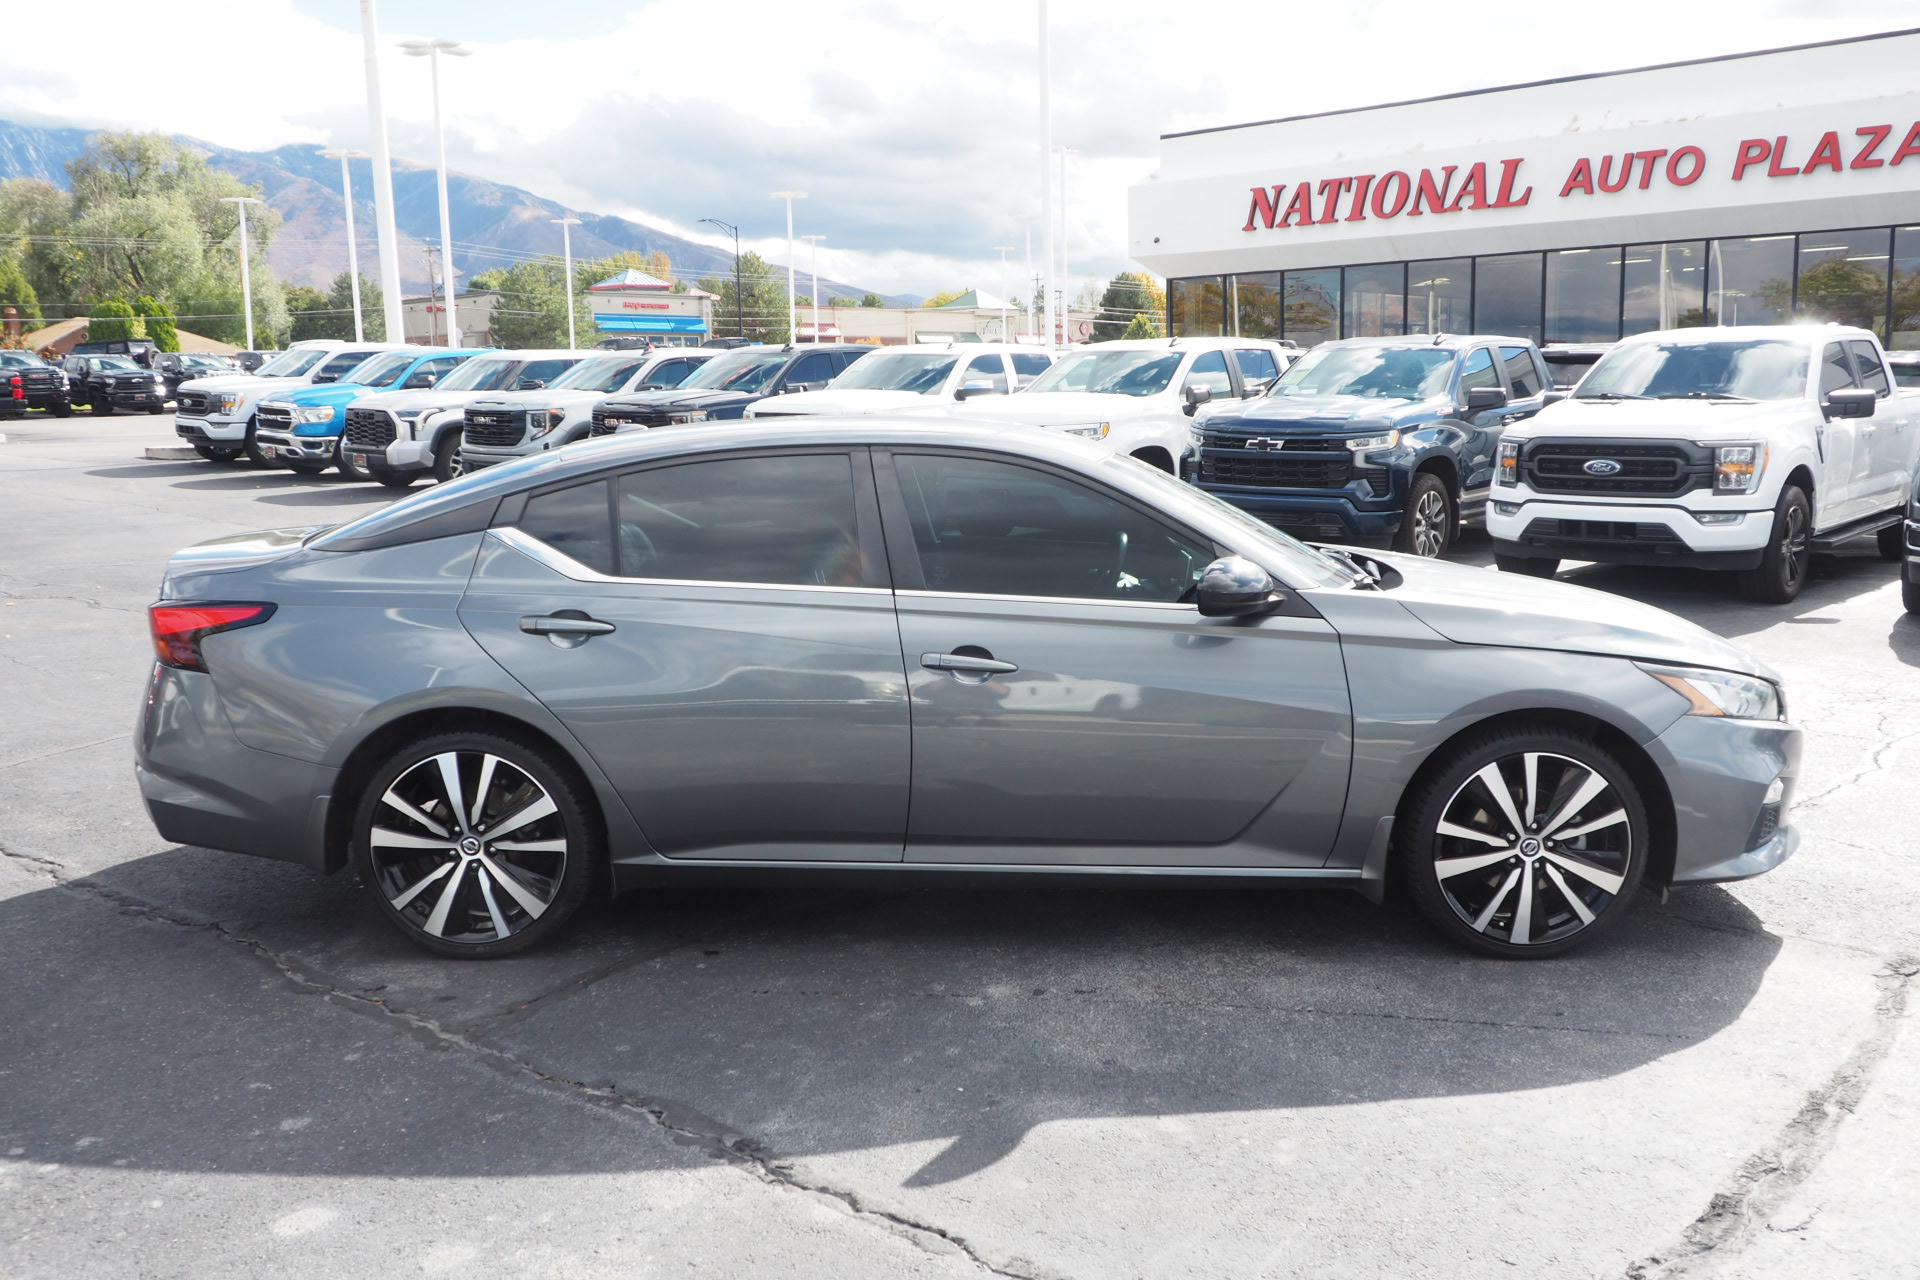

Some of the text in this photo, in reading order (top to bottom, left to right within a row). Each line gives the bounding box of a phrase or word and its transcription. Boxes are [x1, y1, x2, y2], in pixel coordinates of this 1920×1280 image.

[1242, 120, 1920, 231] NATIONAL AUTO PLAZA
[473, 416, 497, 424] GMC
[1591, 462, 1612, 472] Ford
